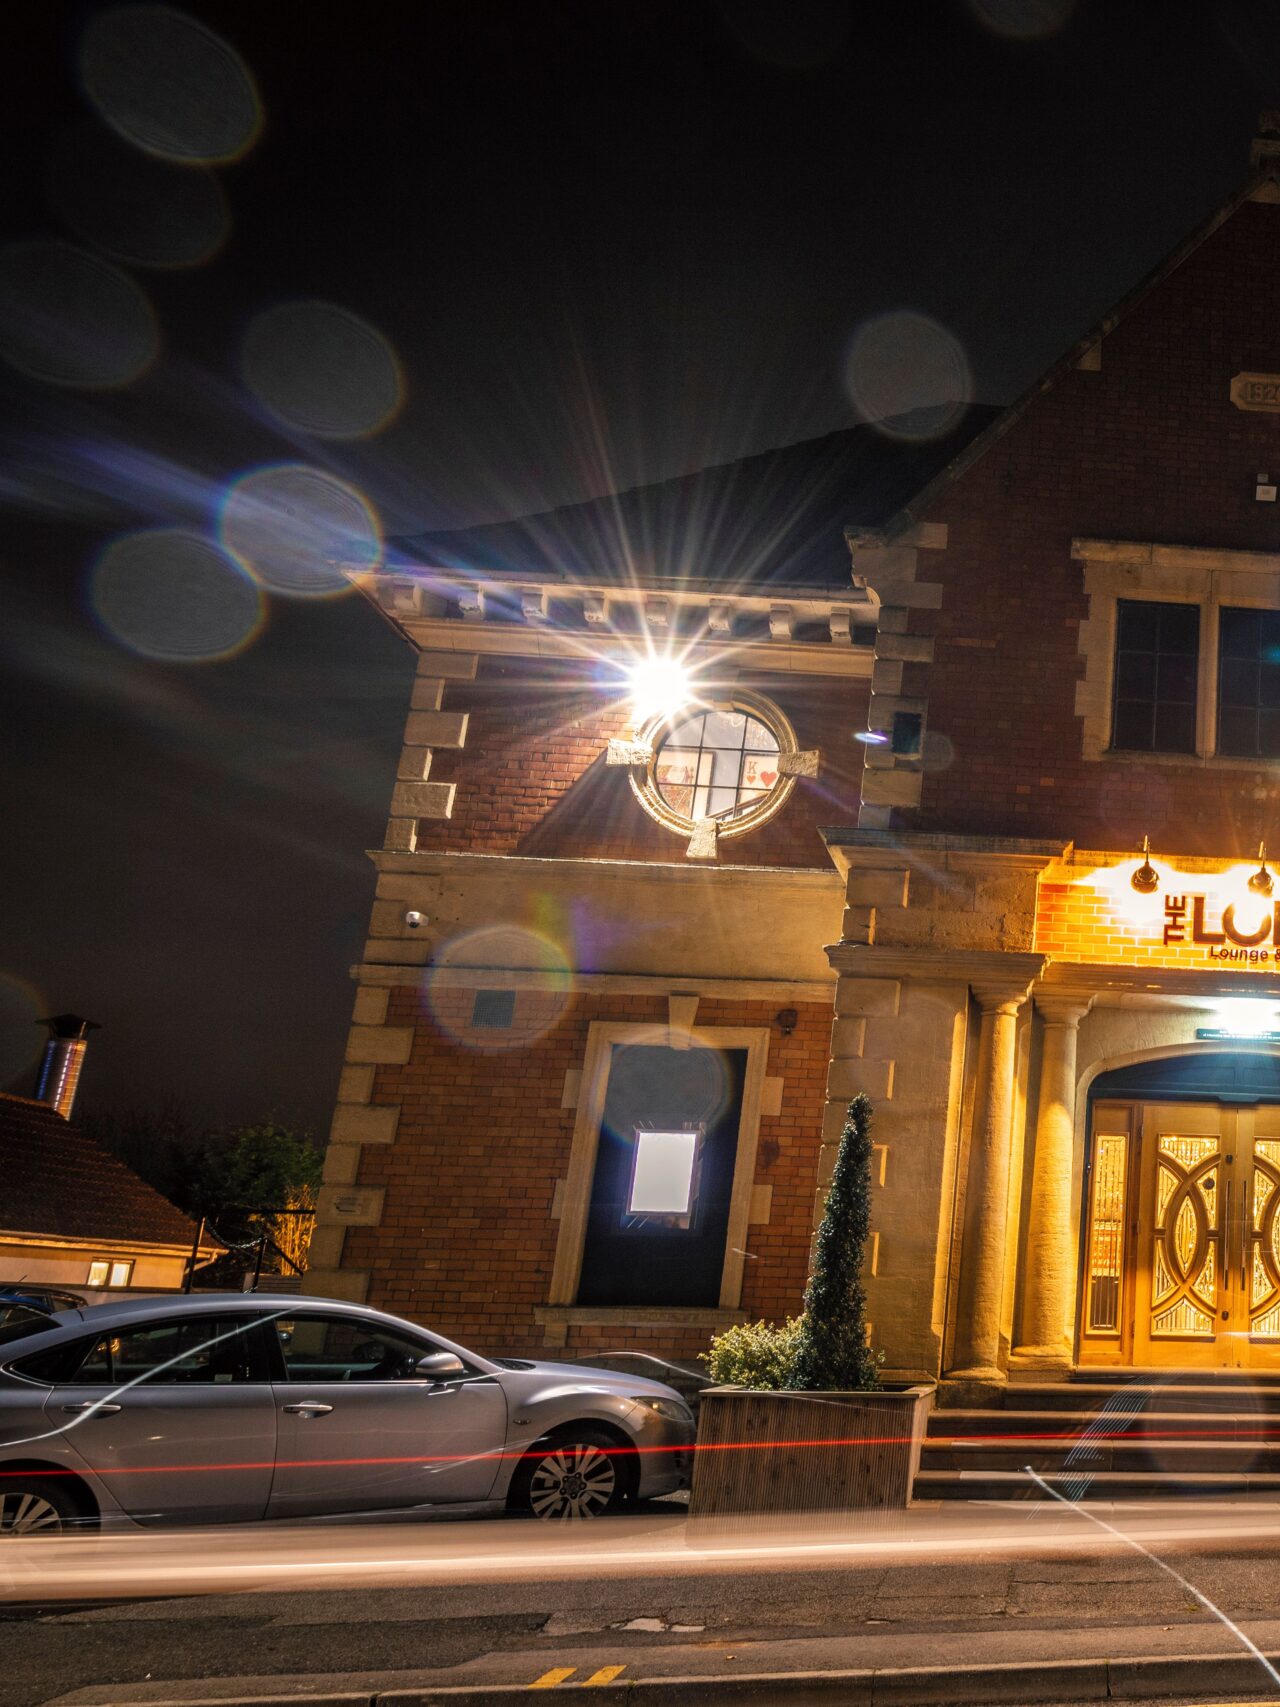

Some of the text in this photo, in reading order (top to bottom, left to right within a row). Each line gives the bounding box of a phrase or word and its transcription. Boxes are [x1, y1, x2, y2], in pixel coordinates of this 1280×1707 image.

[748, 761, 758, 774] K
[1163, 894, 1186, 945] THE
[1210, 946, 1269, 962] Lounge
